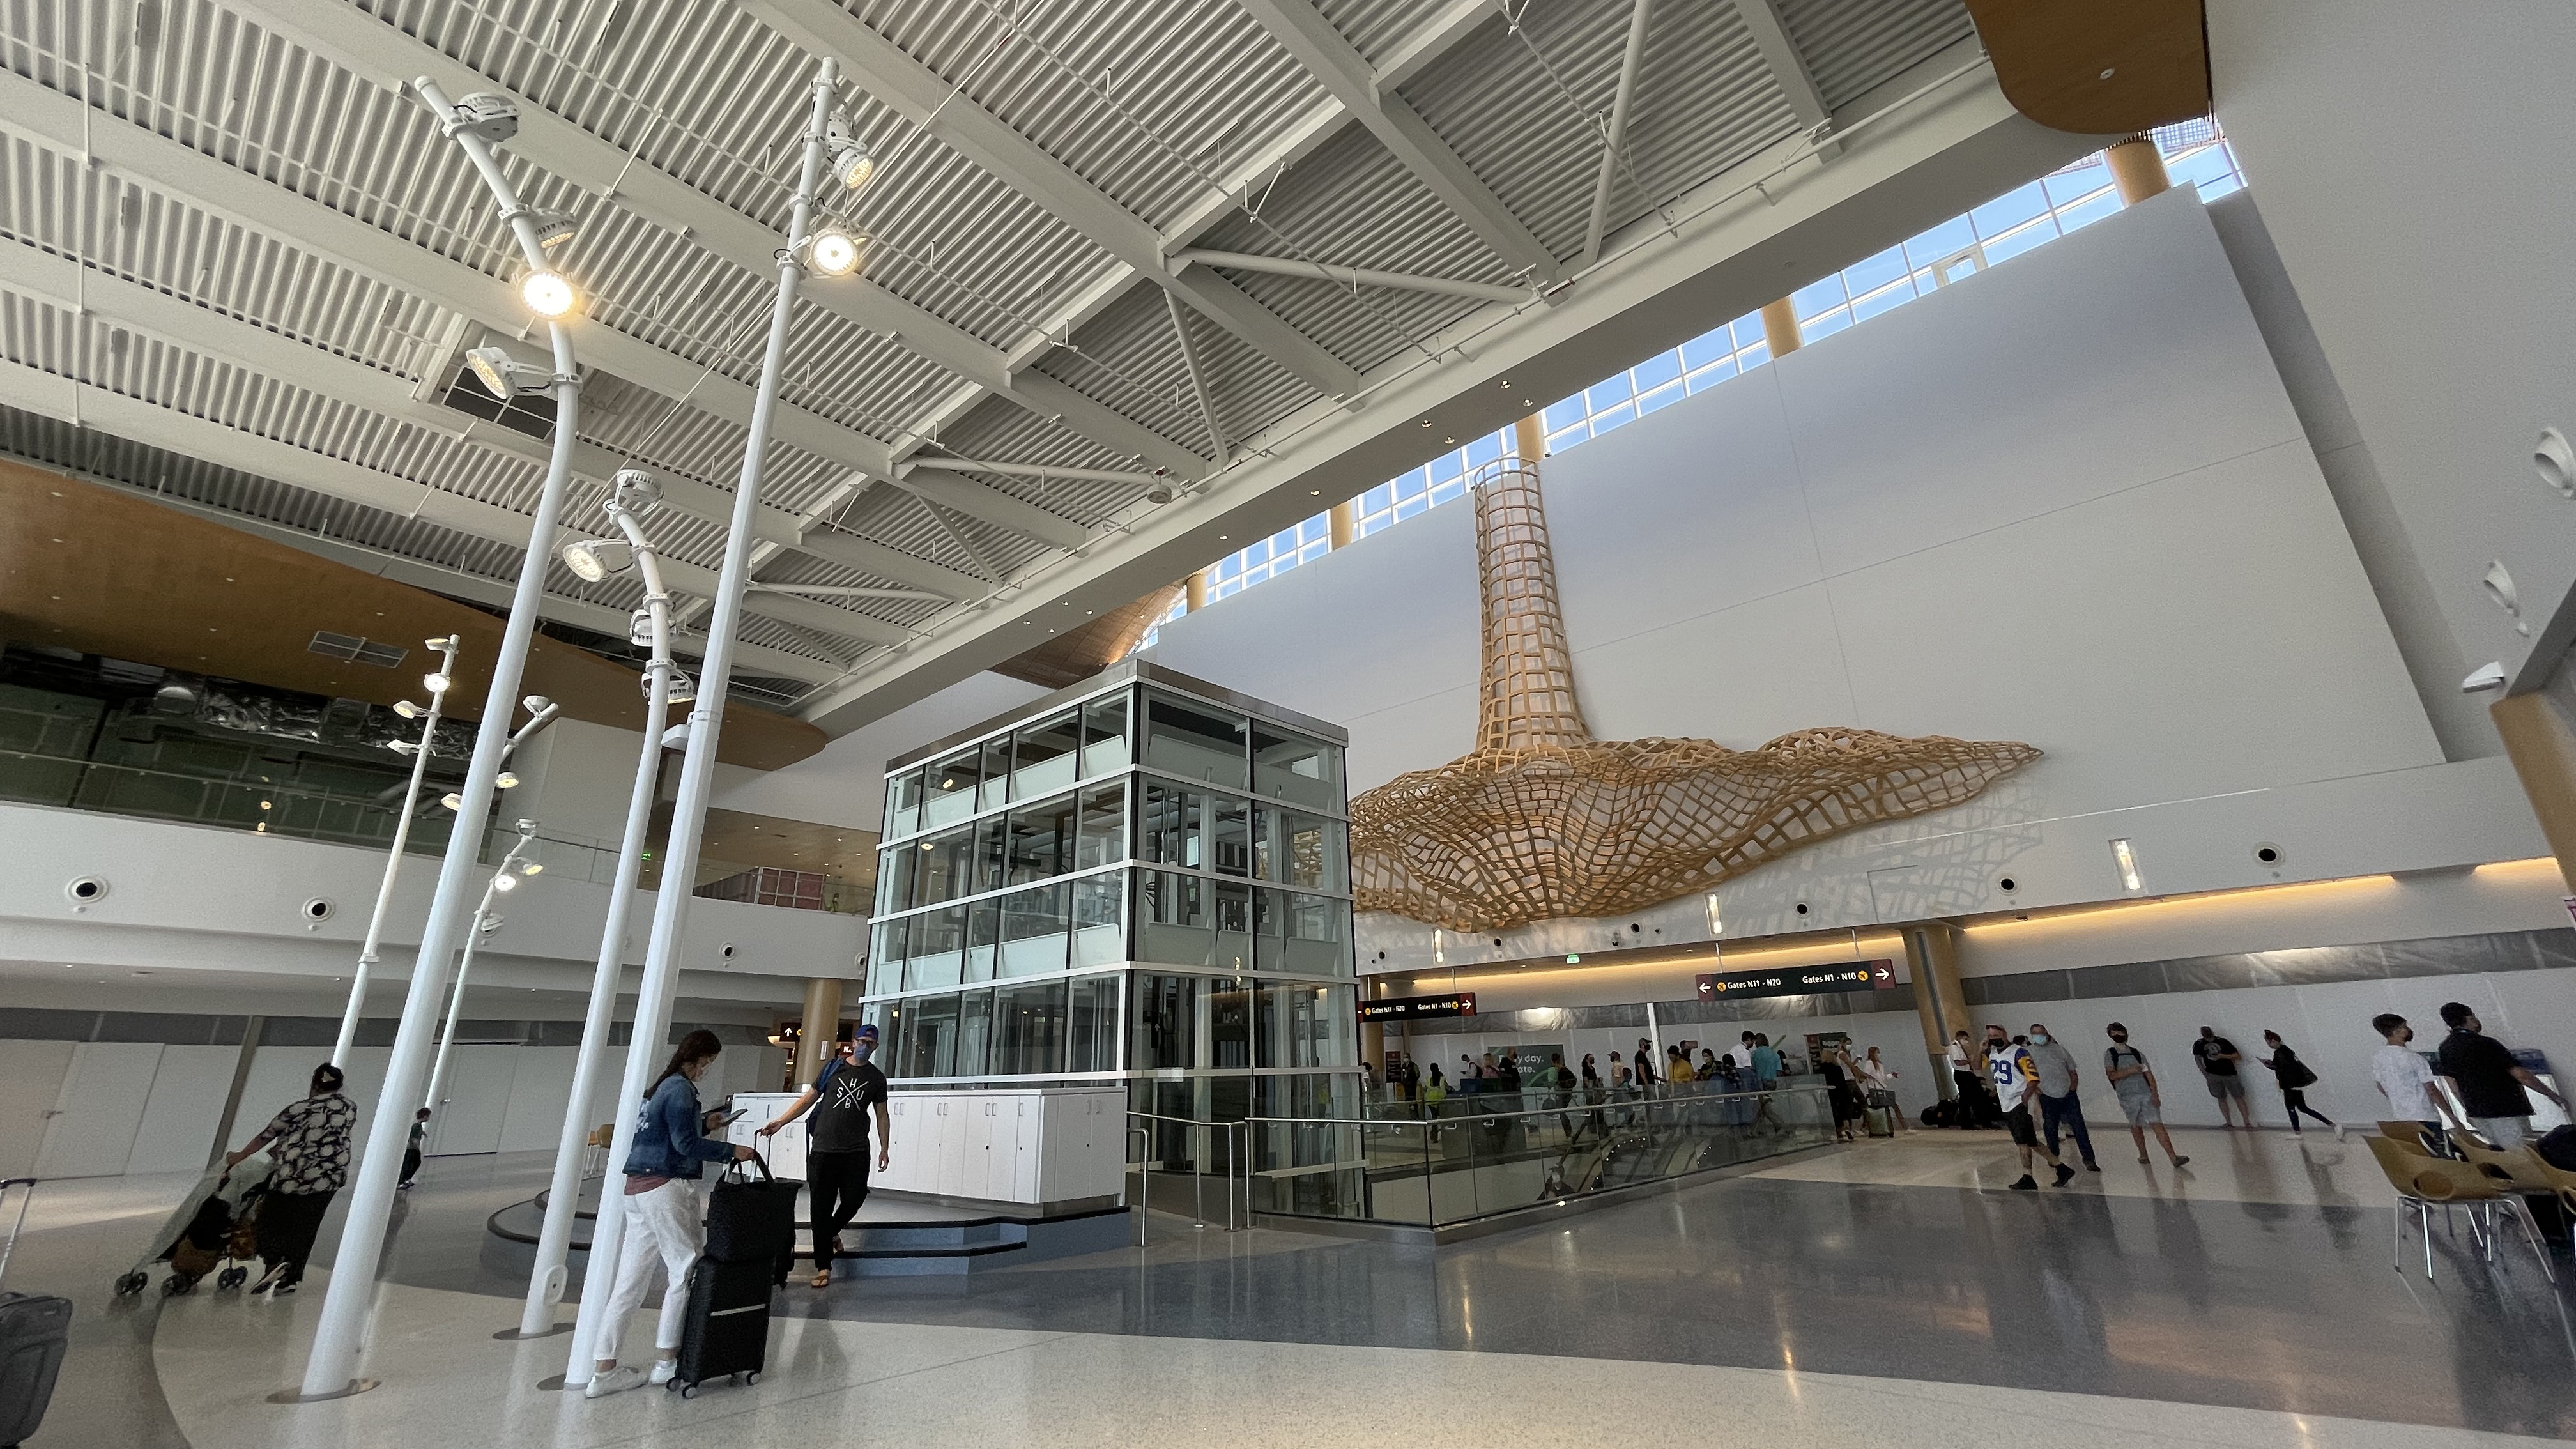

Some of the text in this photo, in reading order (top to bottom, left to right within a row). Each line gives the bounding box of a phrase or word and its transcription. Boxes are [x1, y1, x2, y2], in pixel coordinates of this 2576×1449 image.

[1824, 974, 1834, 982] N1
[1841, 972, 1857, 981] N10
[1747, 979, 1760, 988] N11
[1766, 977, 1781, 986] N20
[1524, 1054, 1544, 1064] day.
